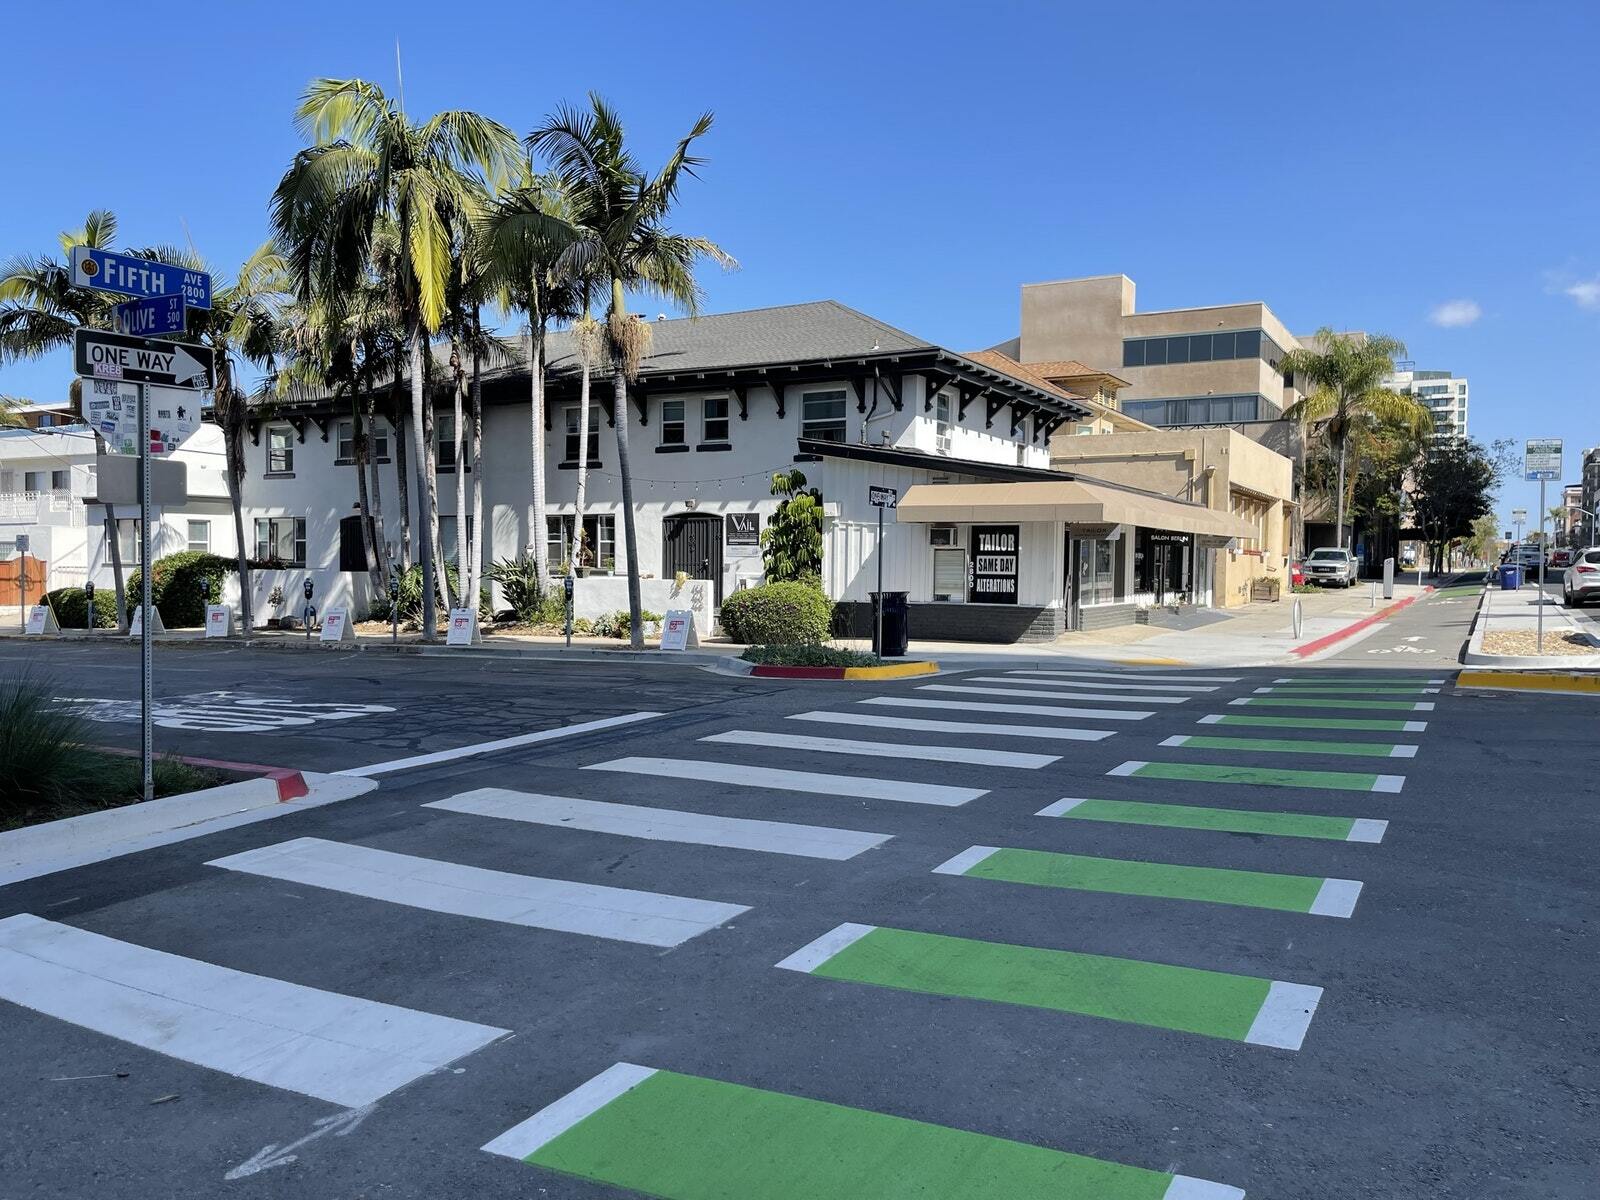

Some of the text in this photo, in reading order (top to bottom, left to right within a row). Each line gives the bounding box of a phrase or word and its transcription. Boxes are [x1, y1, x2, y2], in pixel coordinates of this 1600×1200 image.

[104, 258, 165, 294] FIFTH
[183, 272, 202, 286] AVE
[181, 284, 205, 299] 2800
[169, 297, 178, 309] ST
[123, 307, 155, 335] OLIVE
[167, 311, 180, 323] 500
[91, 345, 174, 372] ONE WAY
[979, 534, 1015, 551] TAILOR
[978, 558, 1014, 572] SAME DAY
[976, 579, 1014, 593] ALTERATIONS
